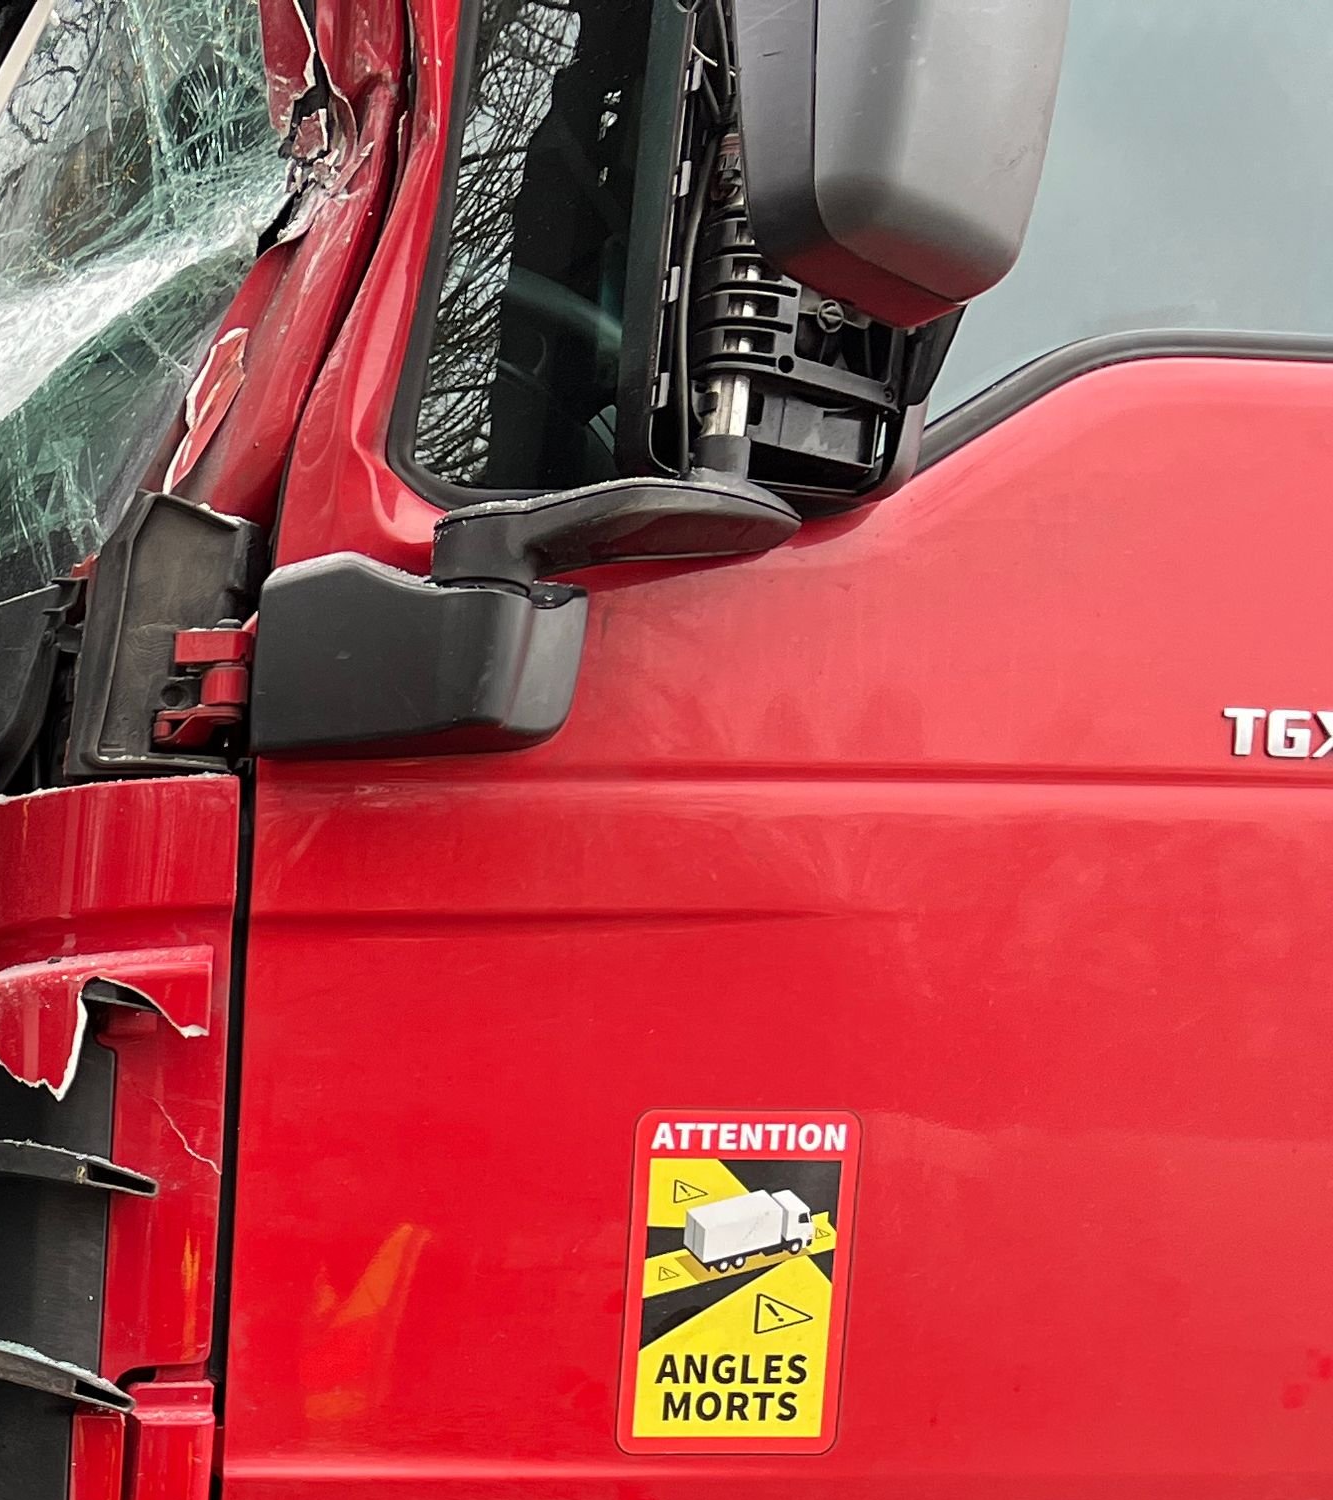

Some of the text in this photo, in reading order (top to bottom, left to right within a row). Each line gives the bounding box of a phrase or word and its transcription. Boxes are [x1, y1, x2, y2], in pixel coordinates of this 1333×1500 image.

[651, 1122, 847, 1152] ATTENTION
[654, 1353, 808, 1386] ANGLES
[662, 1391, 799, 1423] MORTS
